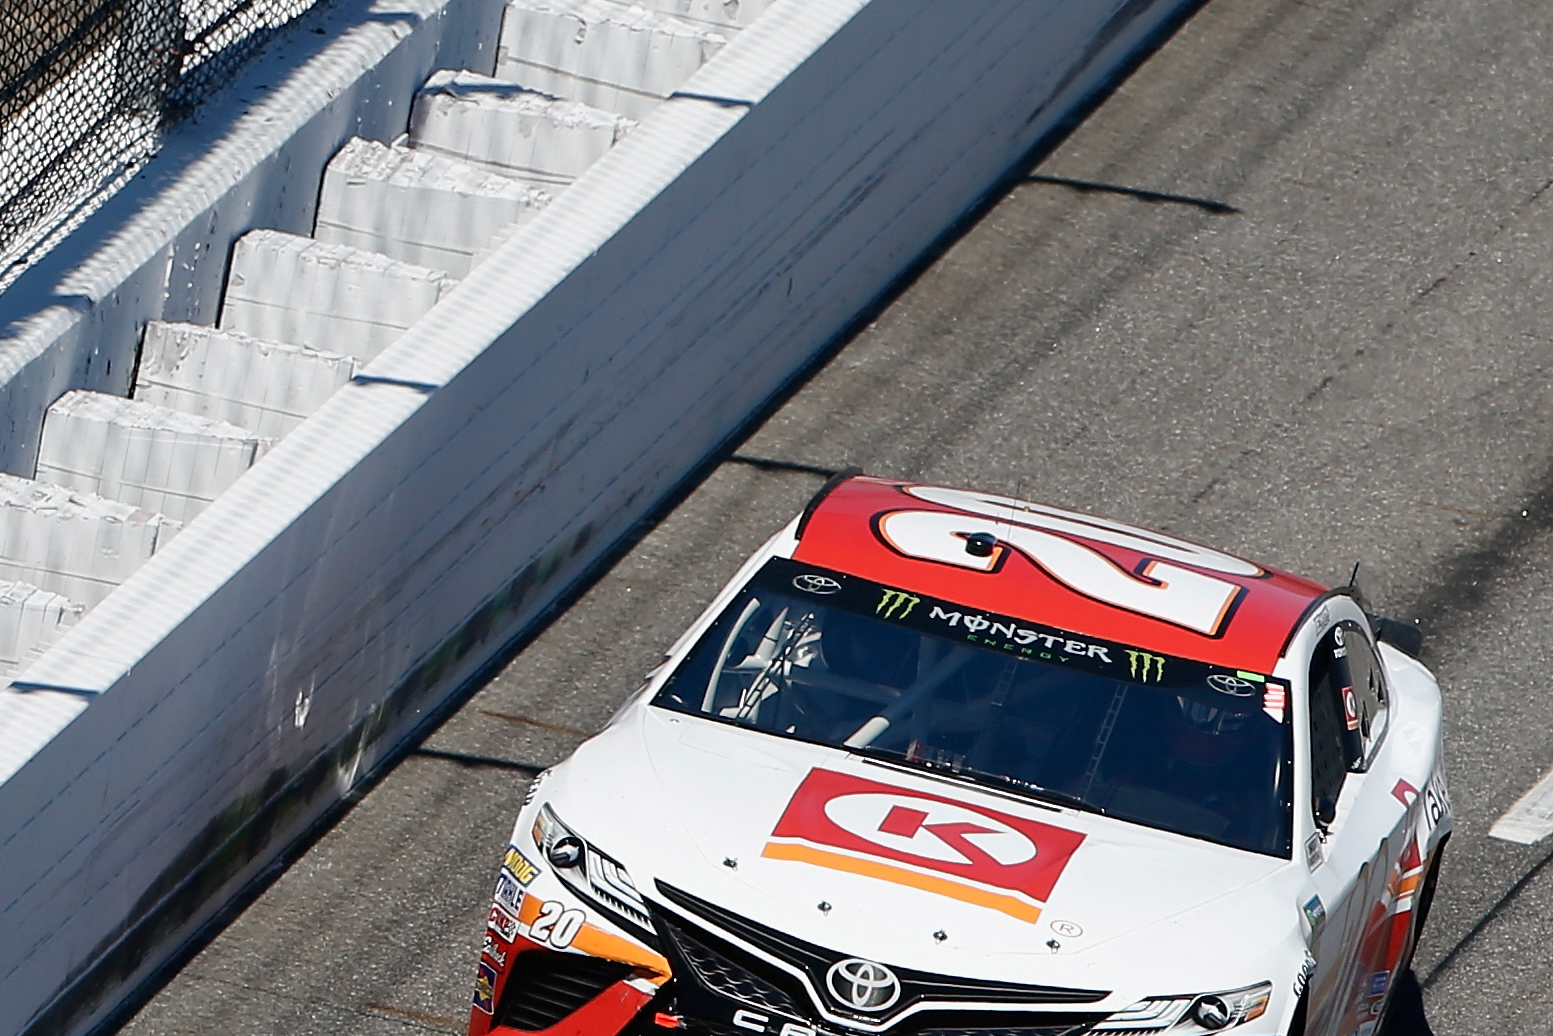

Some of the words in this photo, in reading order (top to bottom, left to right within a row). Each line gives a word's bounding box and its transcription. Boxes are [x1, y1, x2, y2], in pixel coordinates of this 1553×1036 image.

[870, 484, 1273, 639] 20
[929, 606, 1112, 663] MONSTER
[967, 634, 1069, 662] ENERGY
[529, 901, 586, 949] 20
